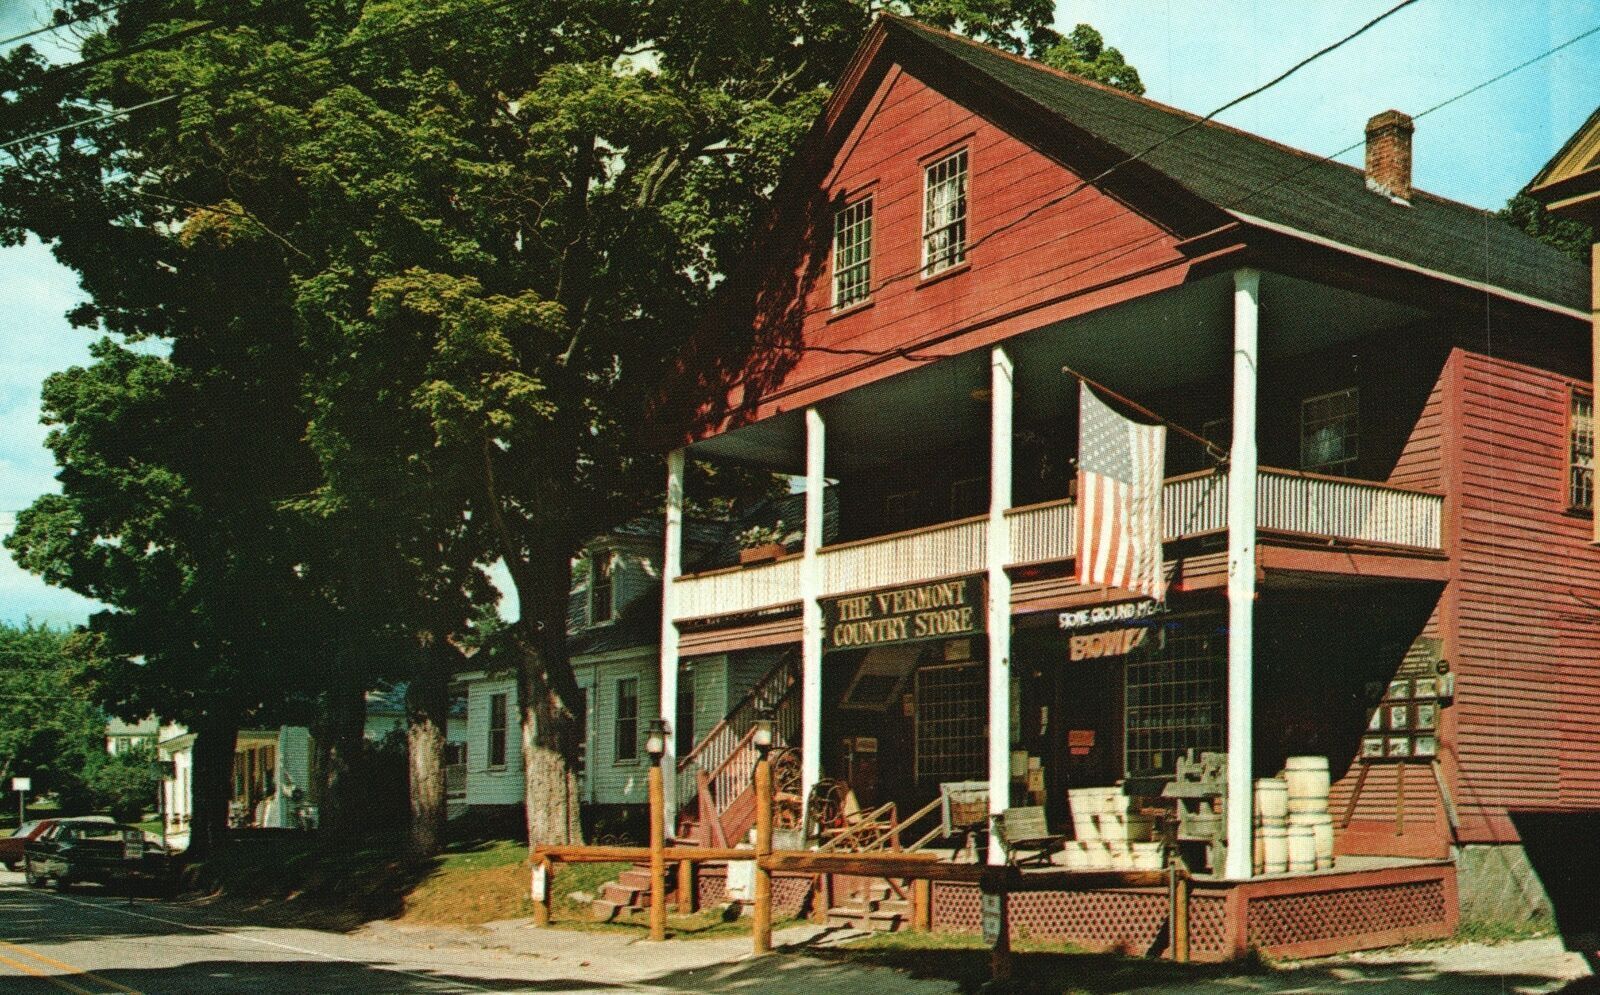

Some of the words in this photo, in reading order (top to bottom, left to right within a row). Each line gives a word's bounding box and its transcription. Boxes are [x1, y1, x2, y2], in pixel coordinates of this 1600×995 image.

[837, 596, 872, 622] THE
[875, 580, 966, 615] VERMONT
[1091, 603, 1135, 624] GROUND
[833, 615, 910, 646] COUNTRY
[914, 606, 974, 637] STORE
